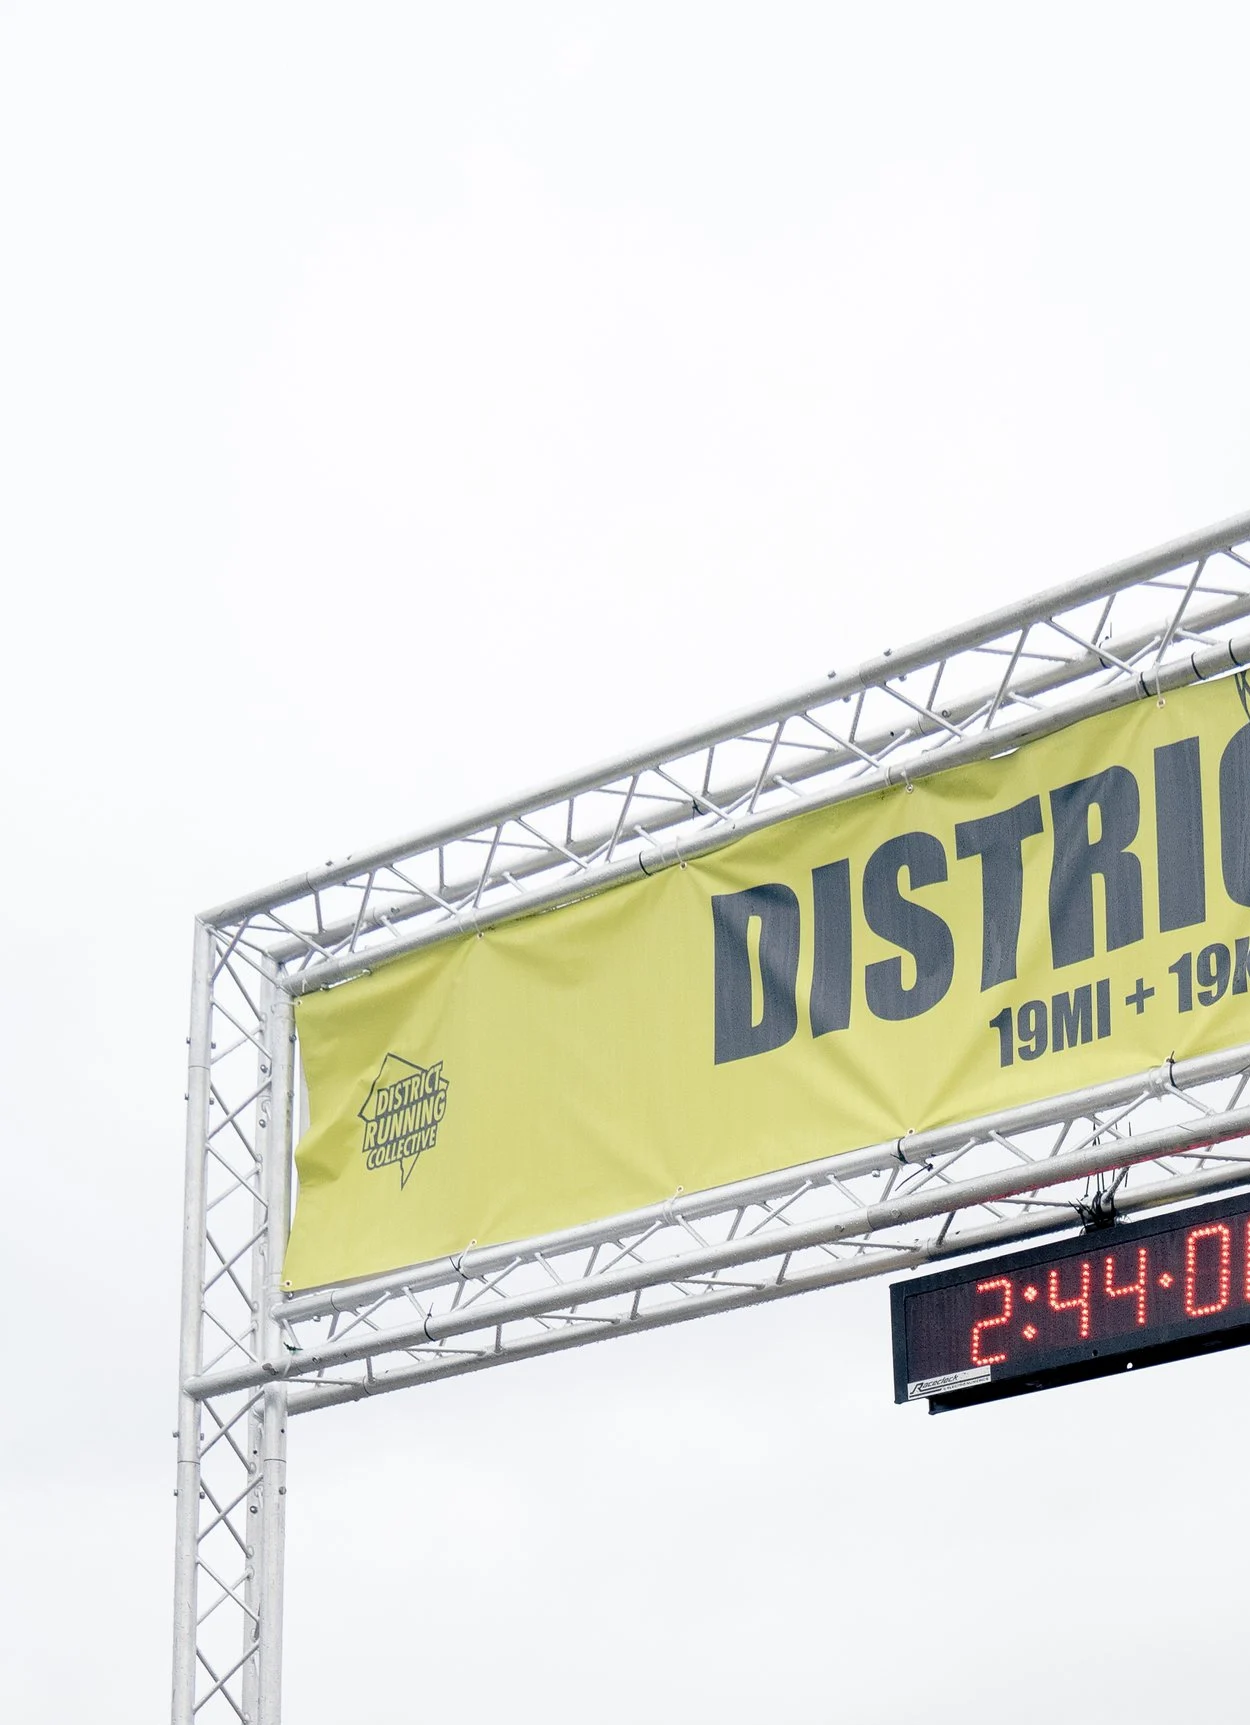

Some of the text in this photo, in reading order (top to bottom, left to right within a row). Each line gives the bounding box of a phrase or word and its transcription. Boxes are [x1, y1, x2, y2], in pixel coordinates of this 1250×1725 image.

[989, 978, 1111, 1068] 19MI
[376, 1061, 443, 1116] DISTRICT
[363, 1090, 446, 1151] RUNNING
[367, 1124, 437, 1169] COLLECTIVE
